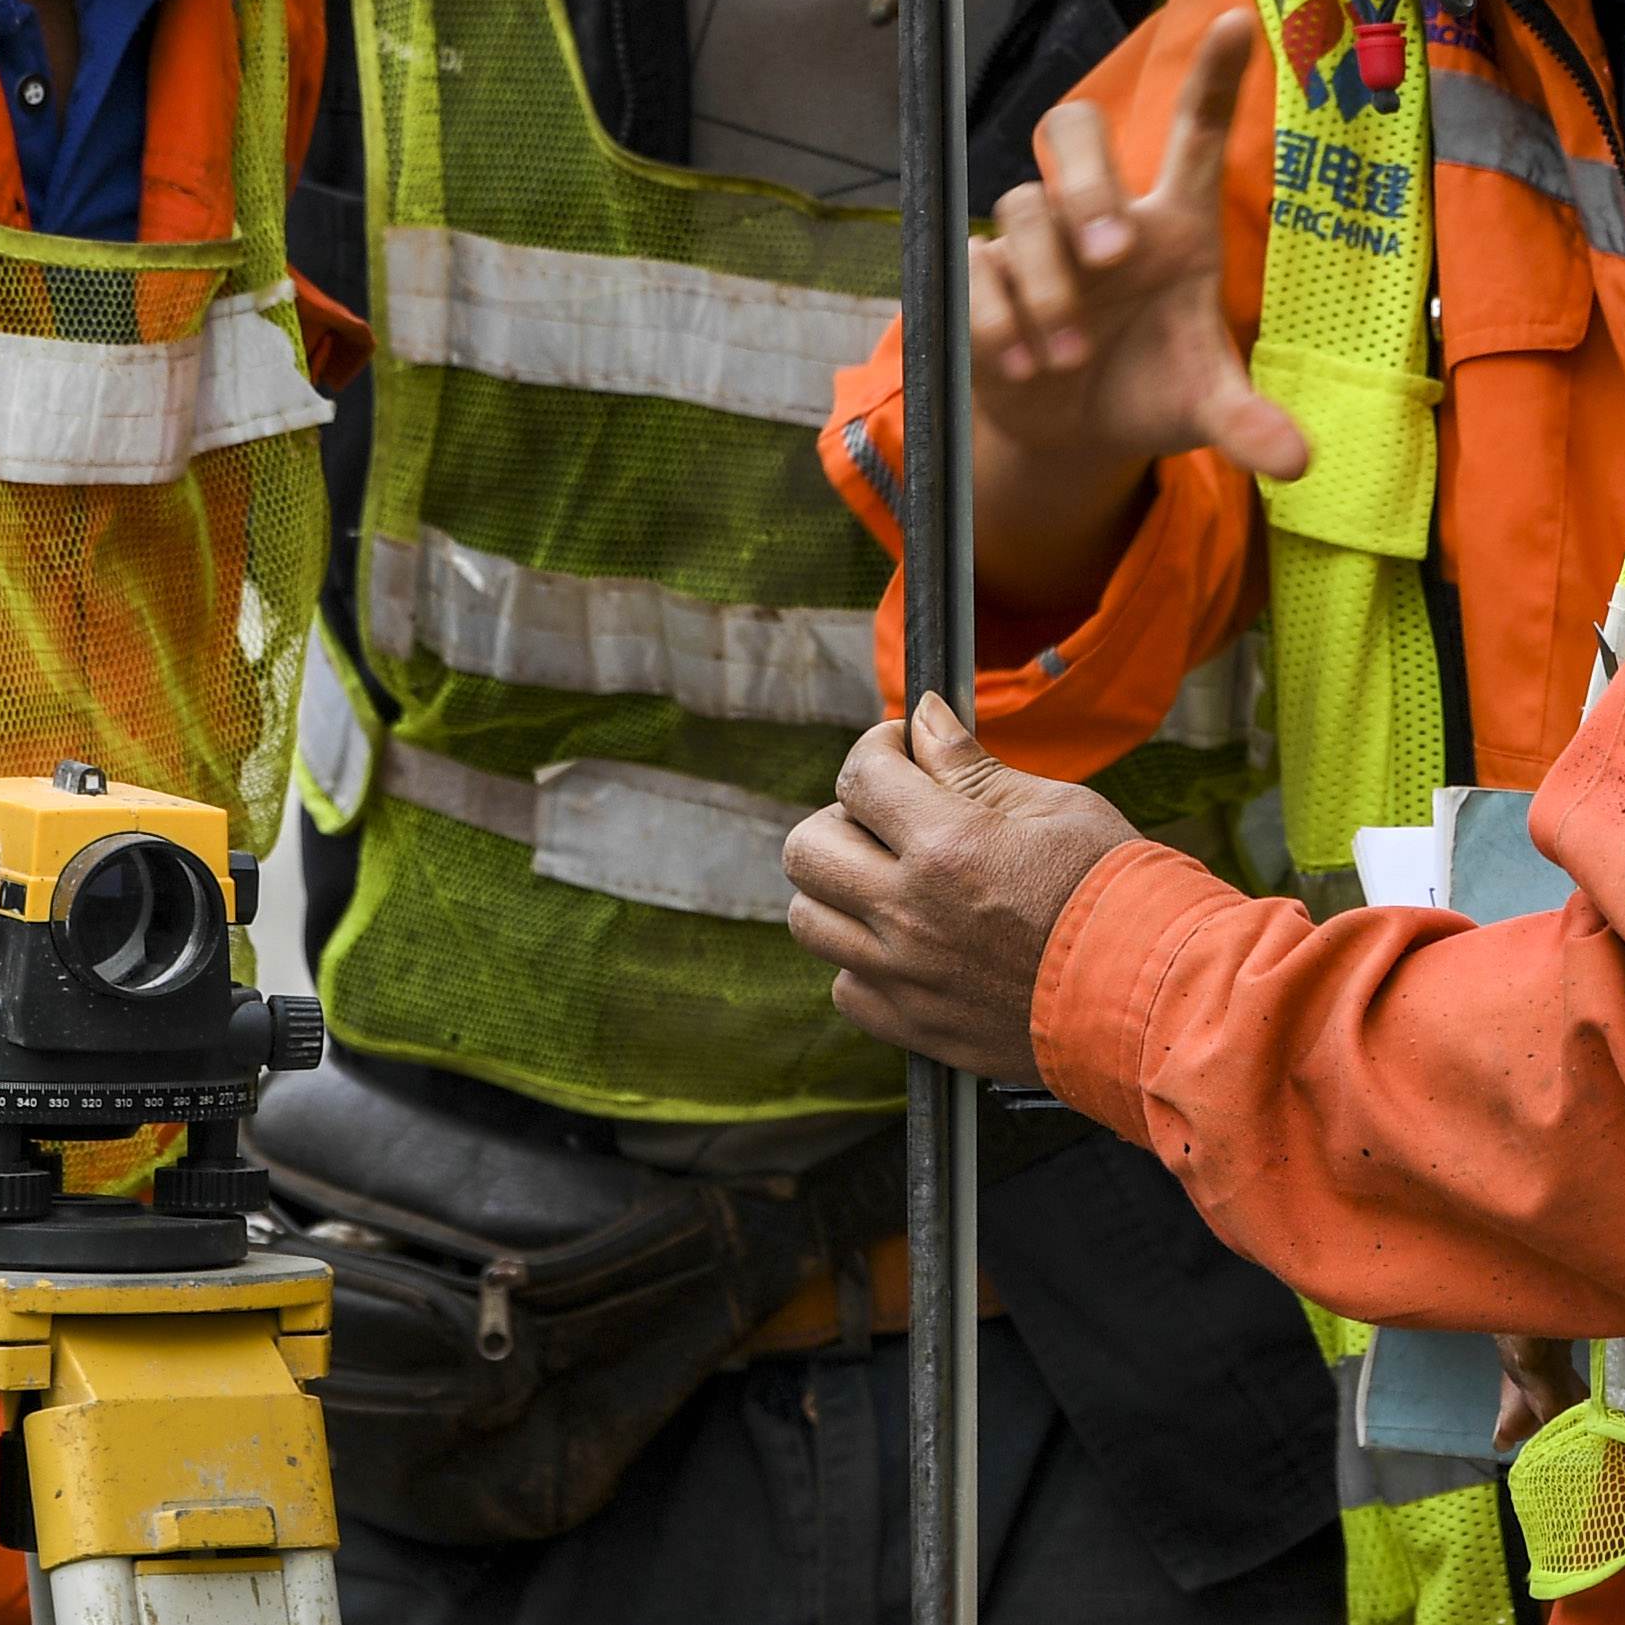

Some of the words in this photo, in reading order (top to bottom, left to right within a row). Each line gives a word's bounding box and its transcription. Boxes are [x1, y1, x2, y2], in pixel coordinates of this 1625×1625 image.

[1268, 198, 1403, 259] ERCHINA
[16, 1097, 37, 1108] 340
[48, 1098, 70, 1108] 330
[81, 1098, 102, 1108] 320
[114, 1098, 133, 1108] 310
[144, 1097, 164, 1108] 300
[173, 1096, 191, 1107] 290
[218, 1092, 234, 1106] 270
